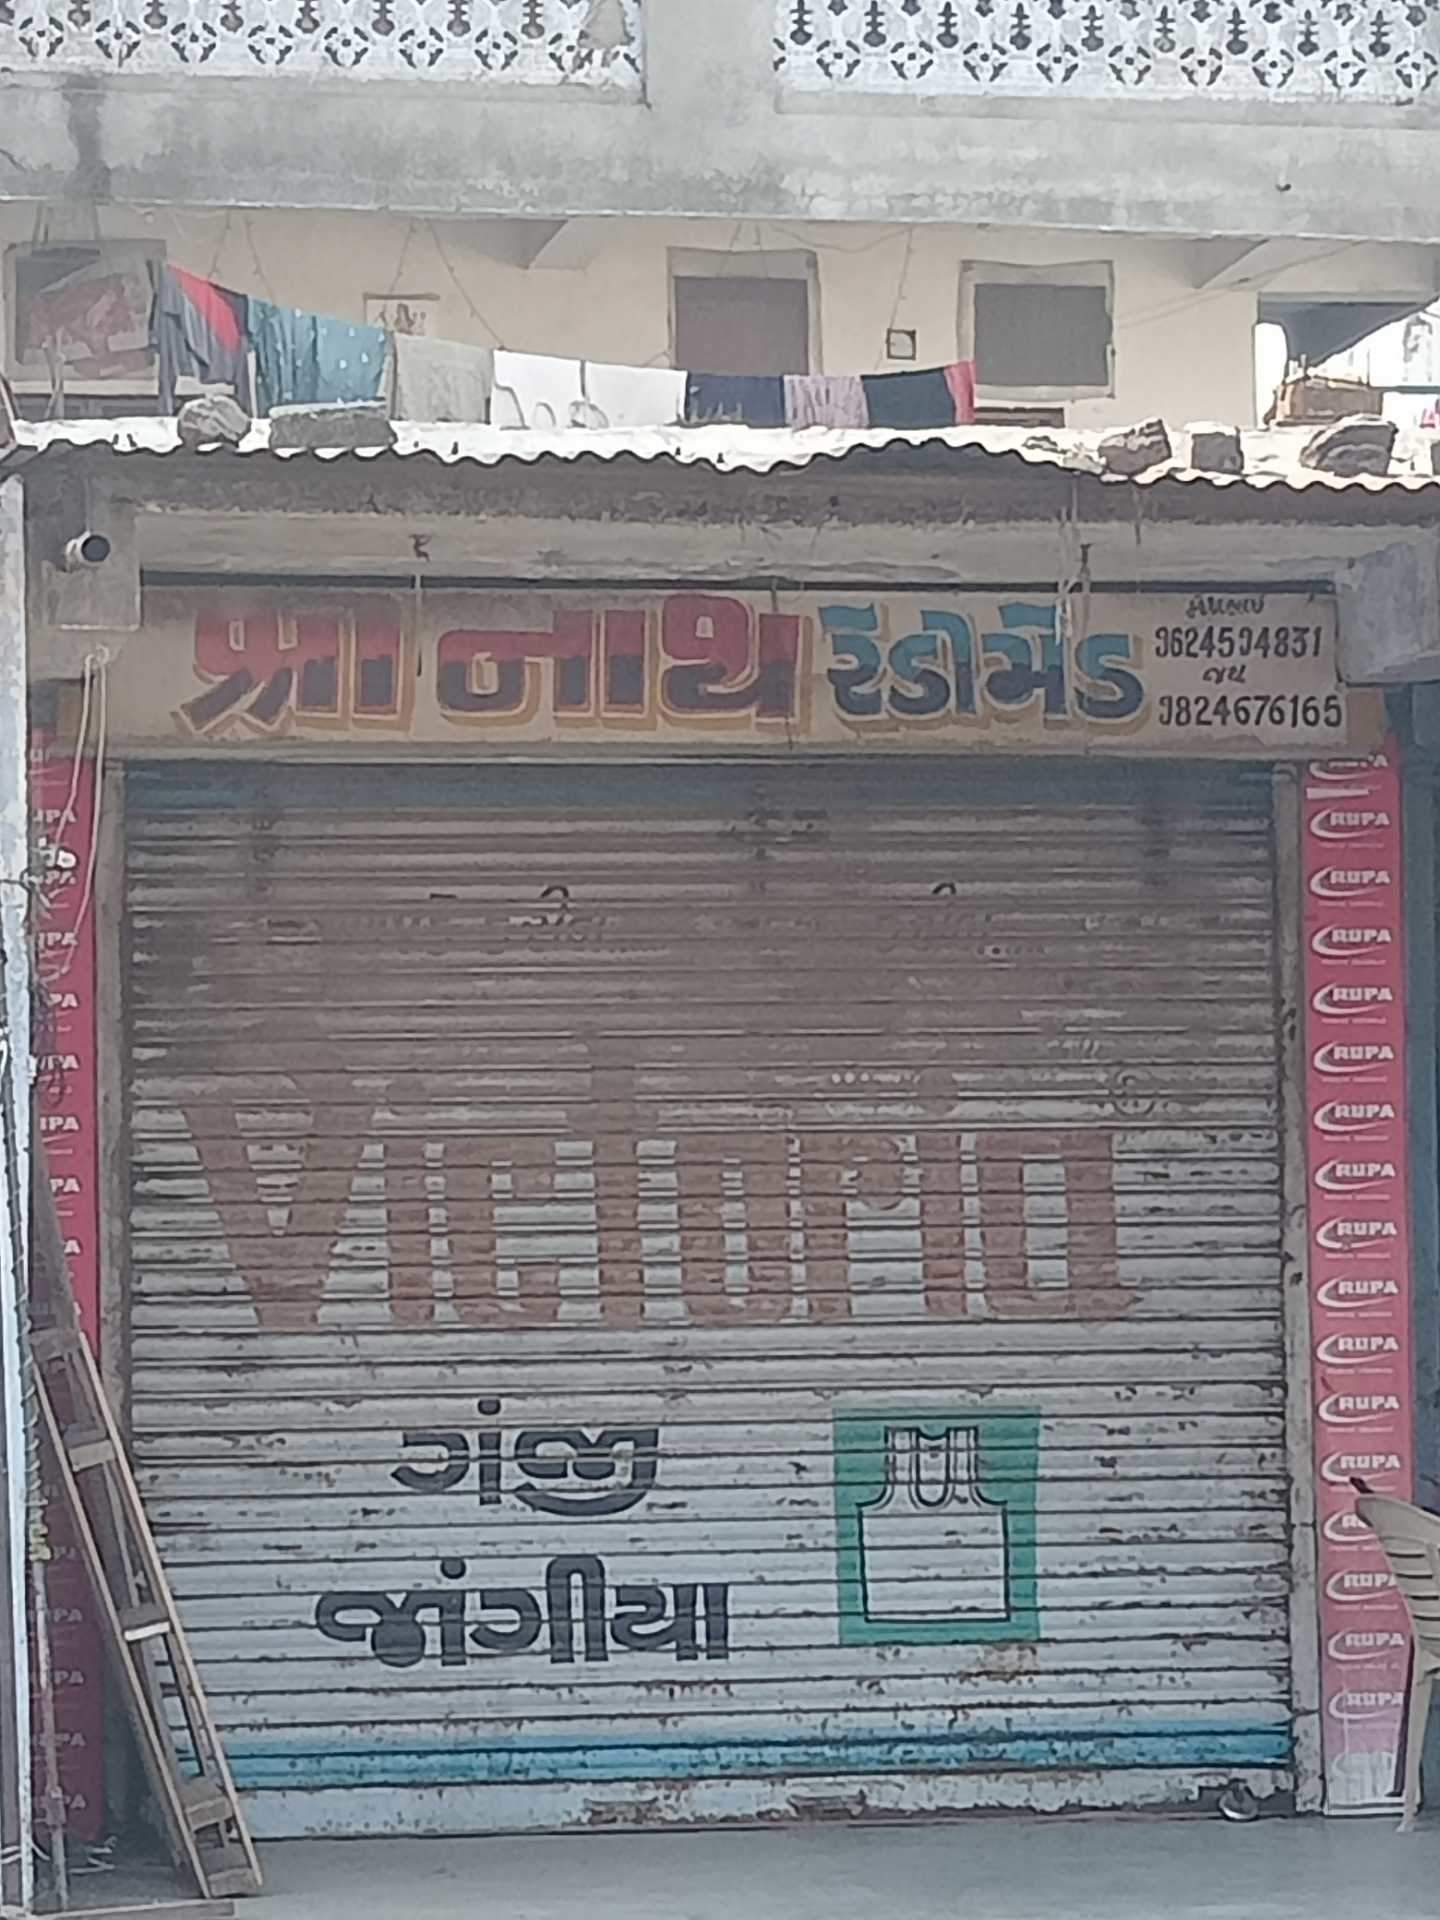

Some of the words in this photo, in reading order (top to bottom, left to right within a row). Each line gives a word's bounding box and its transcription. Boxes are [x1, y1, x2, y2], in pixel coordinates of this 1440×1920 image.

[1154, 625, 1322, 660] 9624594831
[818, 601, 1147, 726] રેડીમેડ
[1158, 693, 1343, 728] 9824676165
[1330, 811, 1390, 827] RUPA
[1330, 870, 1391, 885] RUPA
[1332, 929, 1392, 944] RUPA
[1333, 987, 1393, 1002] RUPA
[1334, 1046, 1394, 1061] RUPA
[1335, 1104, 1395, 1119] RUPA
[1335, 1163, 1396, 1178] RUPA
[51, 1178, 81, 1193] PA
[1337, 1222, 1397, 1237] RUPA
[1338, 1280, 1398, 1295] RUPA
[1338, 1337, 1399, 1351] RUPA
[1339, 1396, 1400, 1410] RUPA
[390, 1399, 659, 1517] ગંજી
[1340, 1455, 1401, 1469] RUPA
[315, 1554, 729, 1668] જાંગીયા
[1345, 1633, 1405, 1647] RUPA
